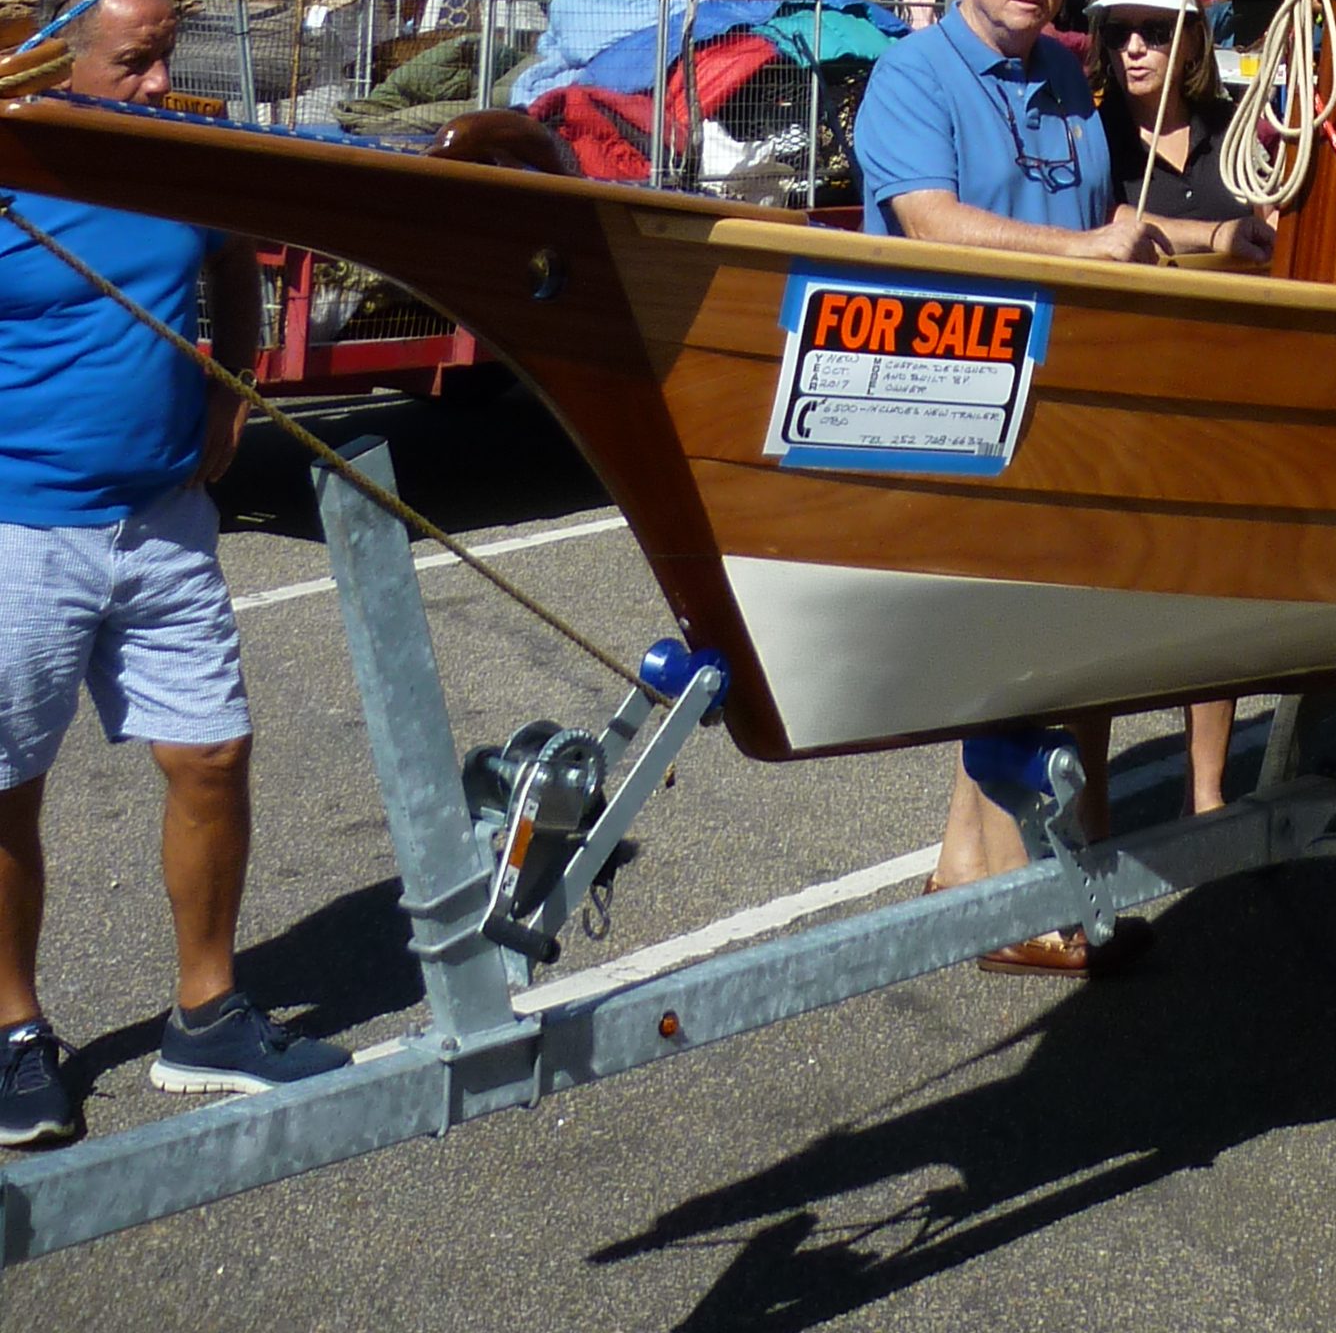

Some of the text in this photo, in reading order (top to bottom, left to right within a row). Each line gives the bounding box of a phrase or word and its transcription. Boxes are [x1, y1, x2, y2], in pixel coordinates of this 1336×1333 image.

[814, 293, 1021, 359] FOR SALE
[808, 353, 823, 391] YEAR
